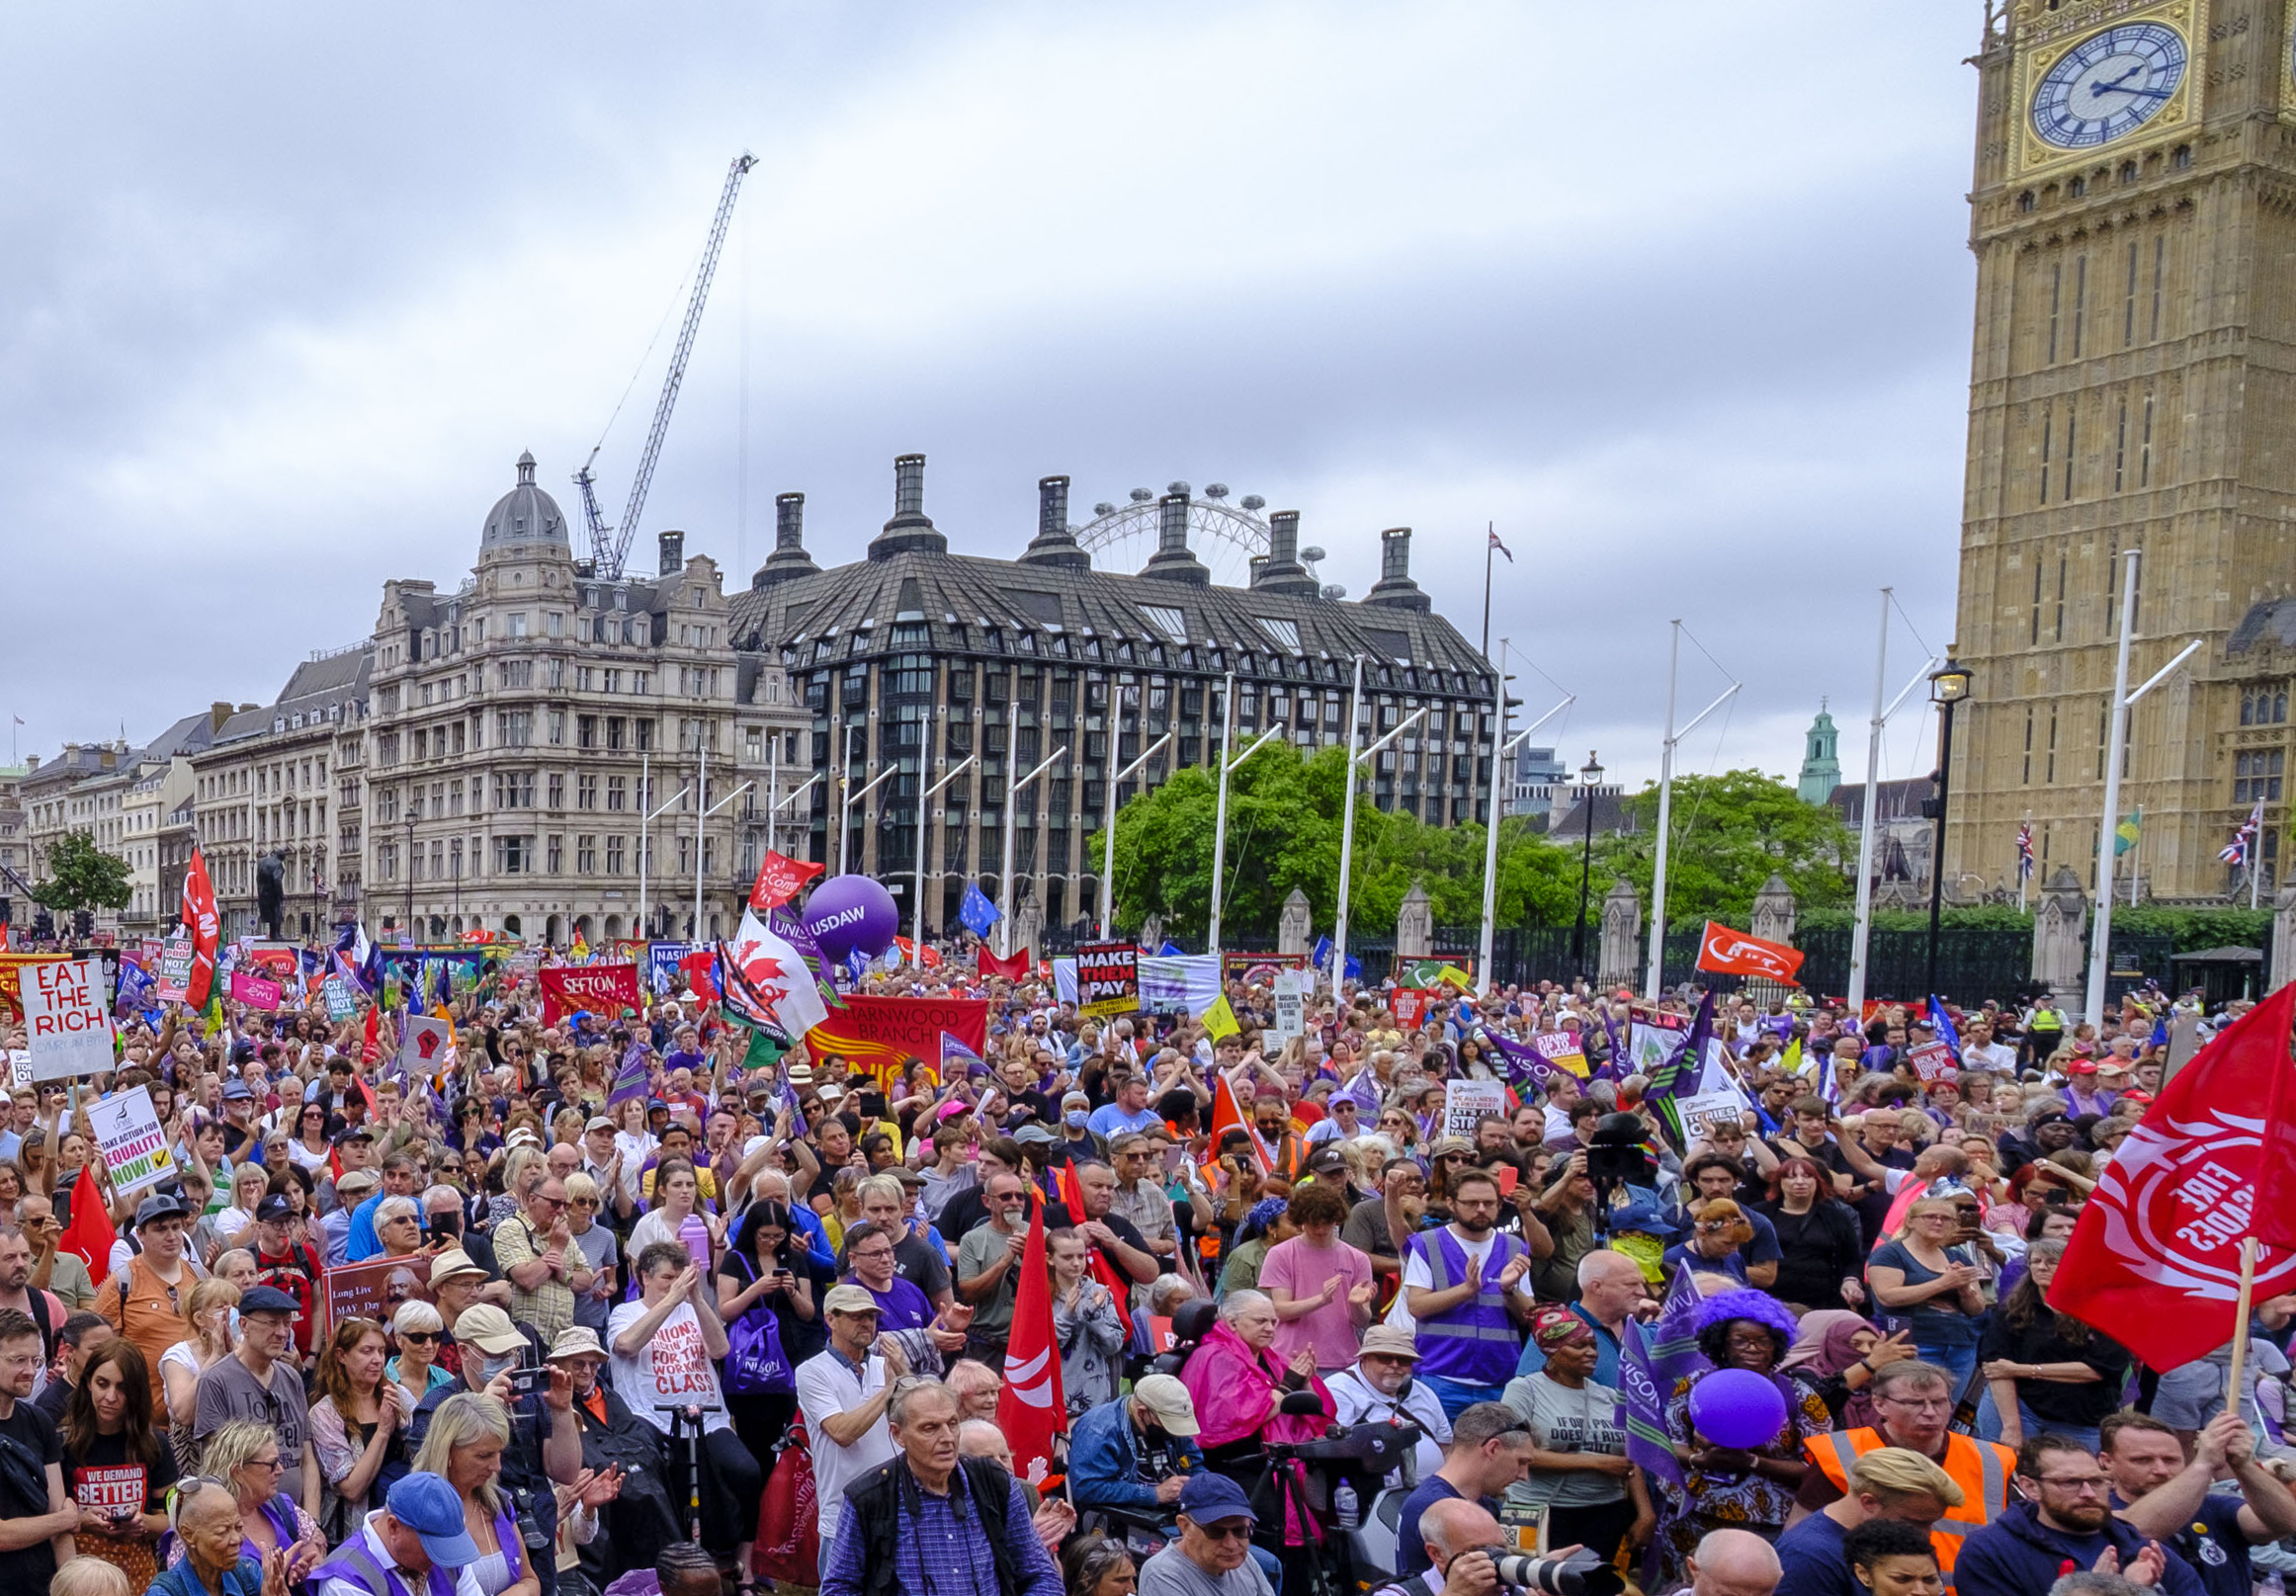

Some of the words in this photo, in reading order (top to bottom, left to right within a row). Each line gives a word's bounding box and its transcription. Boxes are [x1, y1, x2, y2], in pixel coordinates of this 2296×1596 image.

[809, 905, 866, 937] USDAW
[1078, 951, 1135, 967] MAKE
[37, 961, 90, 989] EAT
[1079, 966, 1135, 981] THEM
[563, 973, 617, 996] SEFTON
[1089, 980, 1126, 995] PAY
[40, 985, 92, 1011] THE
[35, 1007, 105, 1036] RICH
[829, 1006, 959, 1027] CHARNWOOD
[858, 1023, 933, 1044] BRANCH
[1536, 1032, 1571, 1044] STAND
[101, 1137, 118, 1150] TAKE
[119, 1126, 144, 1144] ACTION
[144, 1121, 158, 1133] FOR
[105, 1131, 163, 1167] EQUALITY
[112, 1155, 153, 1187] NOW!
[333, 1290, 354, 1300] Long
[355, 1285, 373, 1296] Live
[336, 1303, 358, 1315] MAY
[364, 1302, 381, 1312] Day
[651, 1350, 680, 1365] FOR
[655, 1373, 716, 1395] CLASS
[1557, 1416, 1568, 1427] IF
[87, 1470, 102, 1481] WE
[103, 1468, 142, 1481] DEMAND
[78, 1479, 143, 1504] BETTER
